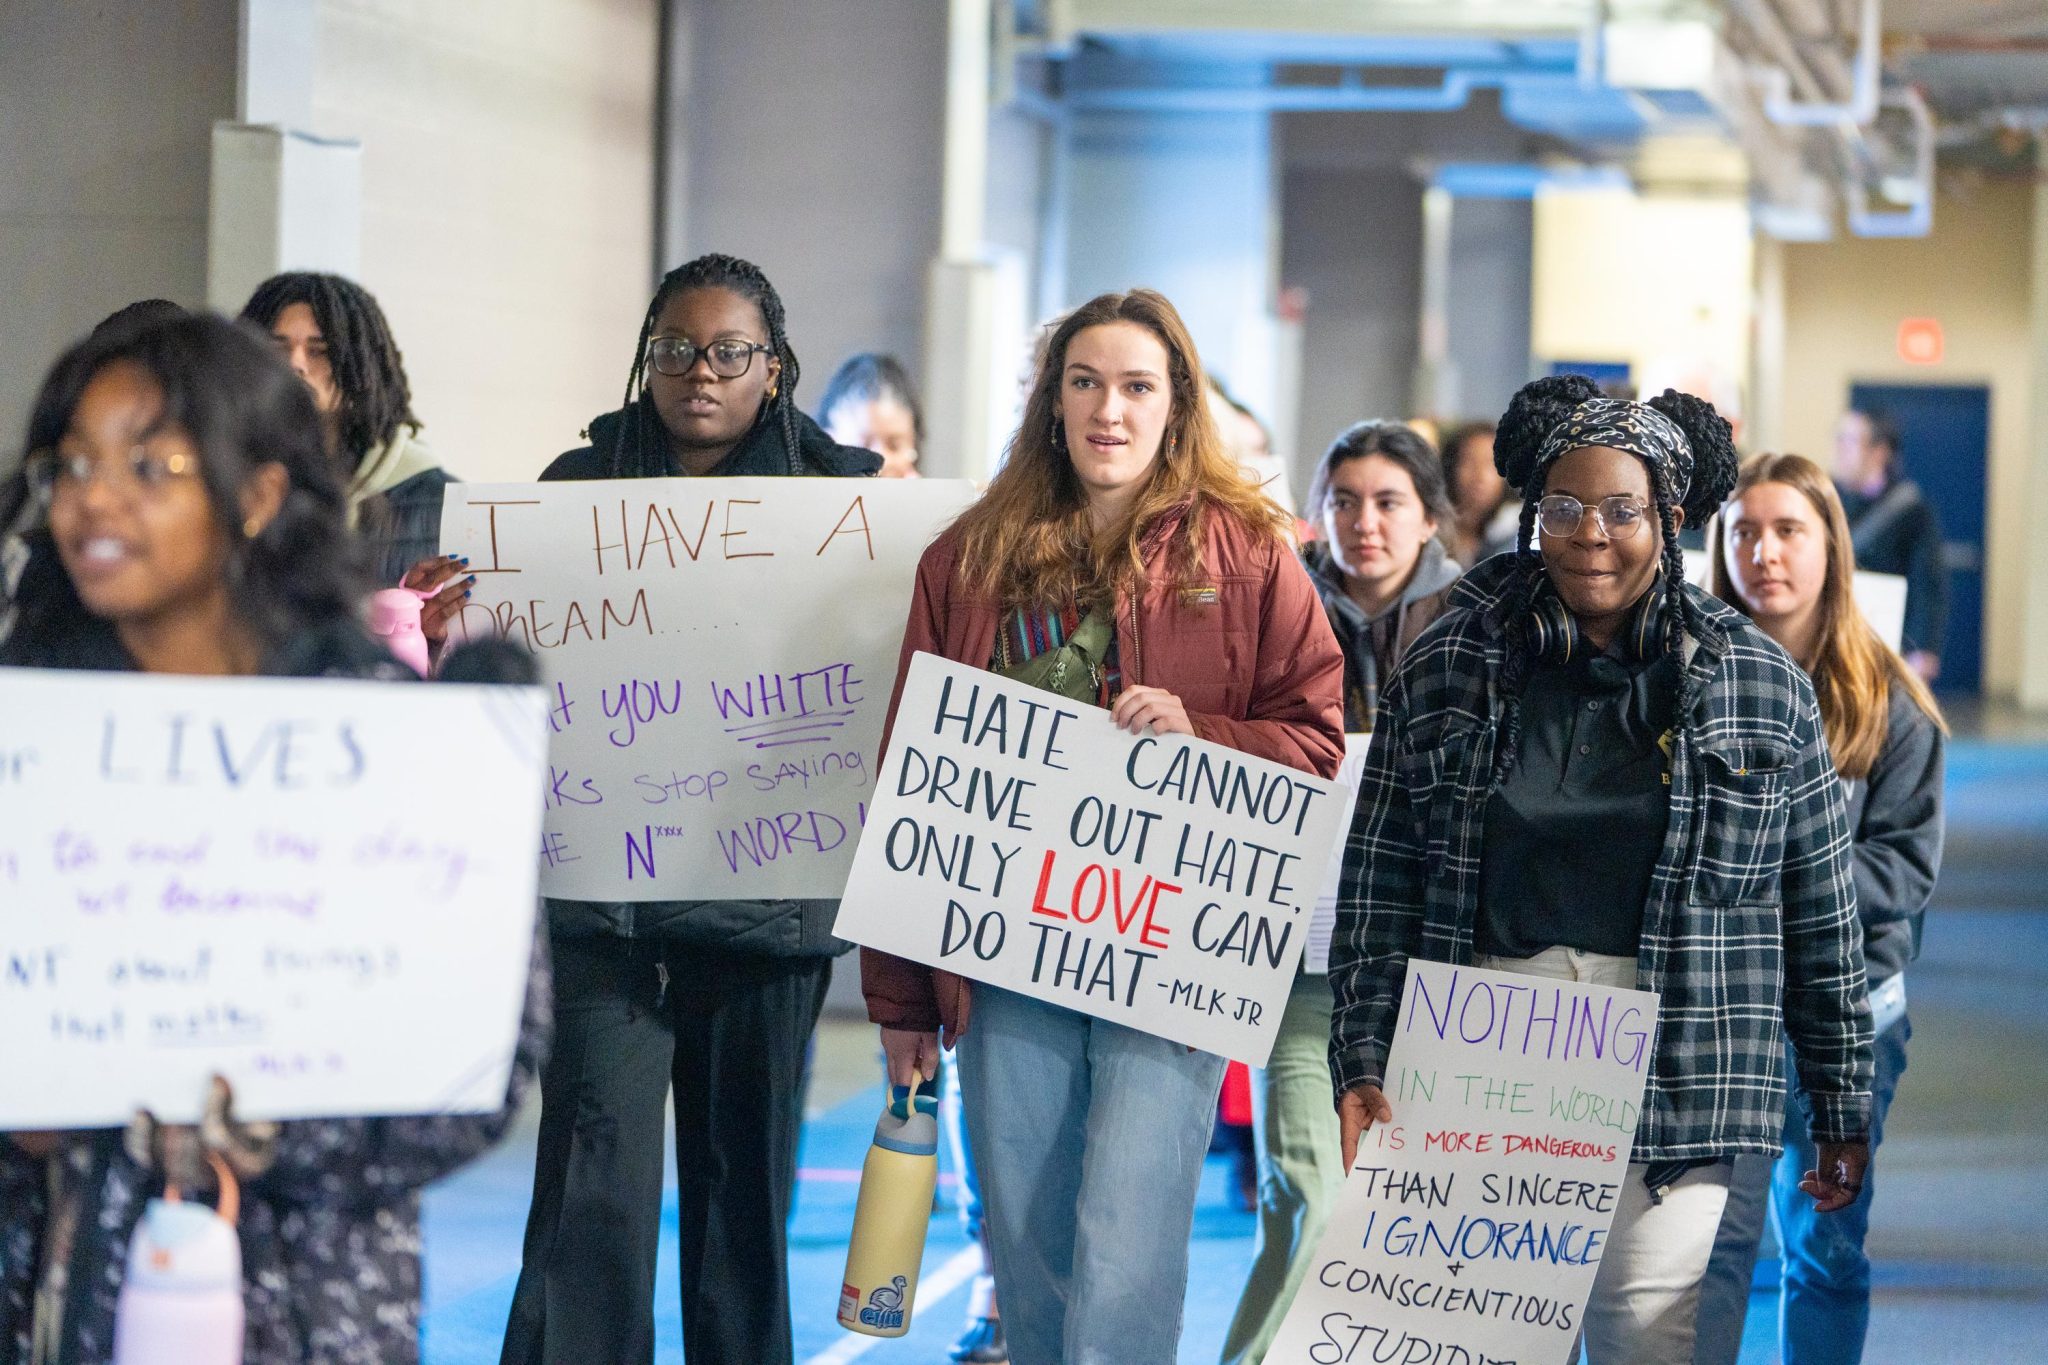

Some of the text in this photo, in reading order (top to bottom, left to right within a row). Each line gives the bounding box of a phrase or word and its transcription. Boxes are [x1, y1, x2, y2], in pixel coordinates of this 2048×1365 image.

[461, 495, 874, 575] I HAVE A
[711, 663, 864, 719] WHITE
[98, 711, 366, 789] LIVES
[933, 676, 1078, 771] HATE
[1126, 738, 1327, 836] CANNOT
[896, 746, 1301, 915] DRIVE OUT HATE,
[885, 817, 1022, 898] ONLY
[1032, 849, 1184, 950] LOVE
[1192, 903, 1293, 971] CAN
[940, 899, 1007, 961] DO
[1028, 921, 1158, 1008] THAT
[1233, 1000, 1263, 1027] JR
[1406, 970, 1647, 1073] NOTHING
[1398, 1067, 1639, 1134] IN THE WORLD
[1377, 1127, 1617, 1162] IS MORE DANGEROUS
[1355, 1166, 1619, 1213] THAN SINCERE
[1362, 1211, 1607, 1266] IGNORANCE
[1319, 1260, 1574, 1331] CONSCIENTIOUS
